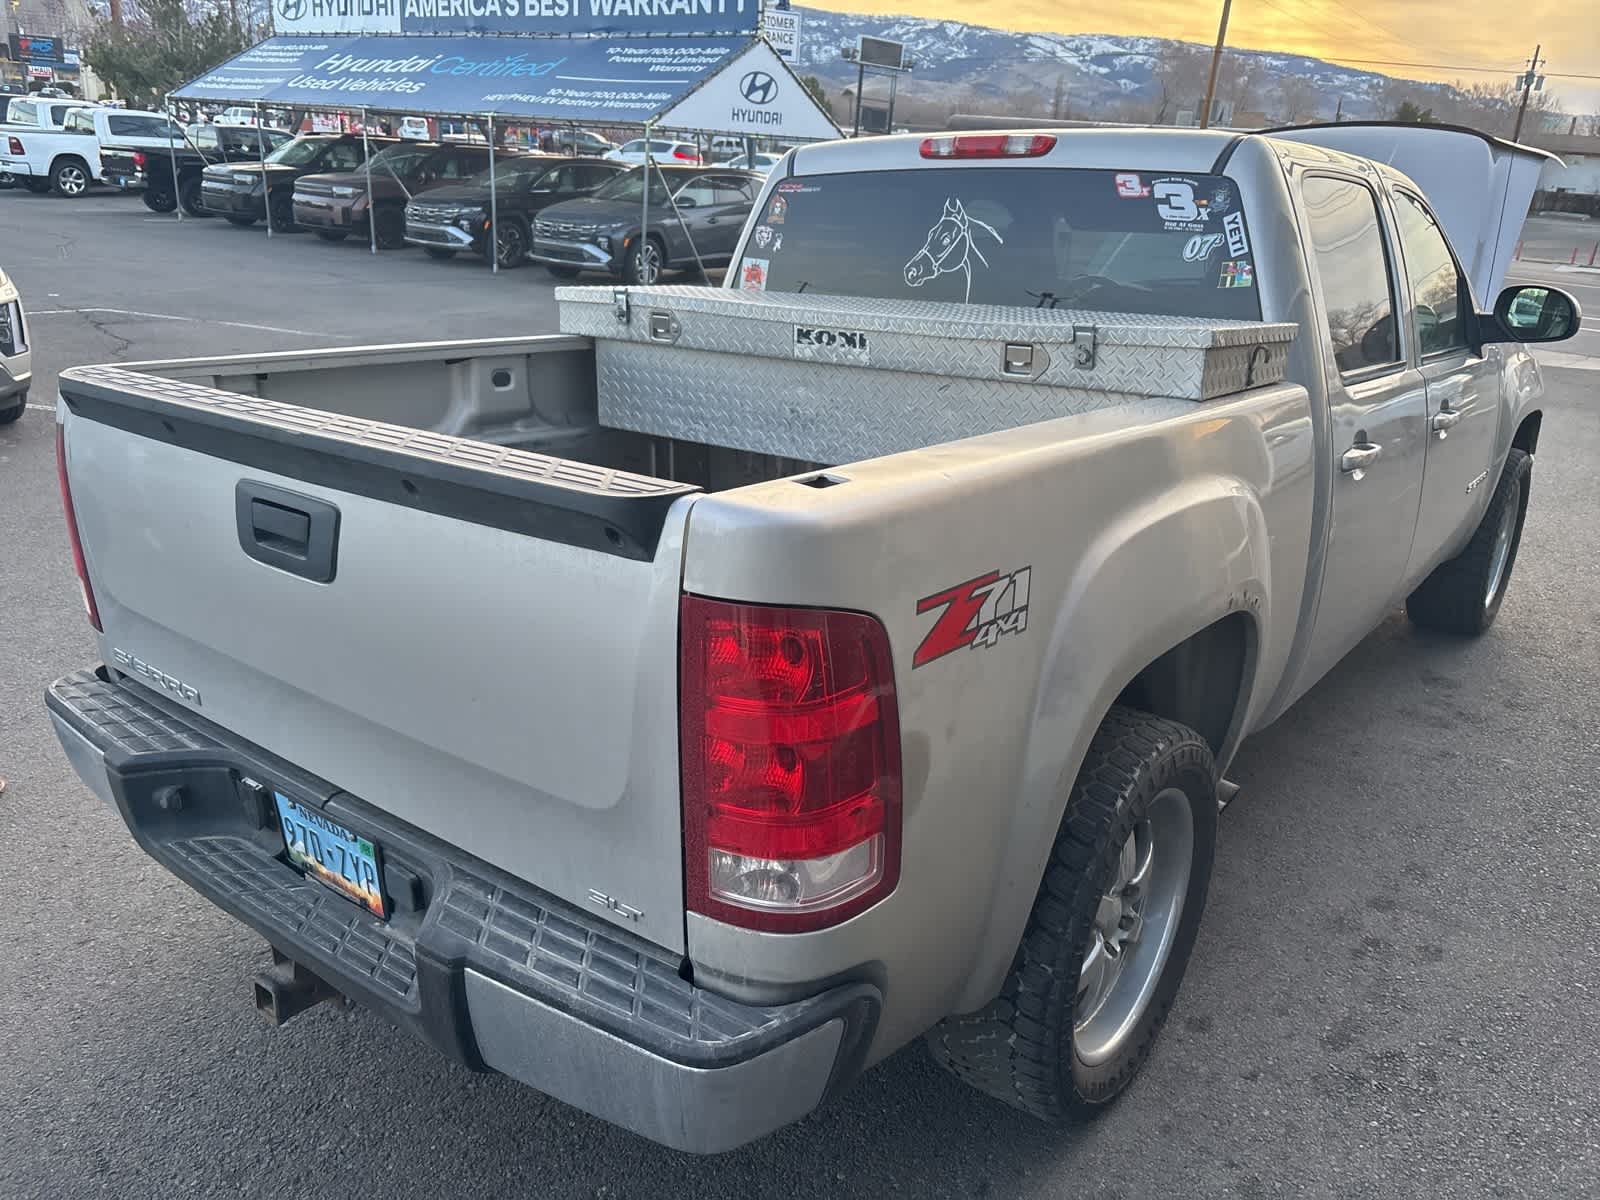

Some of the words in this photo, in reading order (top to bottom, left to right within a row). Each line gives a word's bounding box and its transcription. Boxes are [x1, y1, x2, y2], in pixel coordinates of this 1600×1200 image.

[405, 0, 520, 17] AMERICA'S
[313, 54, 442, 74] Hyundai
[429, 53, 567, 77] Certified
[608, 55, 673, 64] Powertrain
[671, 56, 722, 64] Limited
[648, 65, 707, 74] Warranty
[287, 74, 341, 91] Used
[336, 77, 426, 94] Vehicles
[559, 97, 603, 108] Battery
[602, 100, 662, 110] Warranty
[731, 108, 783, 126] HYUNDAI
[1226, 215, 1245, 254] YETI
[970, 605, 1029, 650] 4x4
[112, 646, 202, 706] SIERRA
[298, 805, 350, 842] NEVADA
[588, 887, 645, 923] SLT
